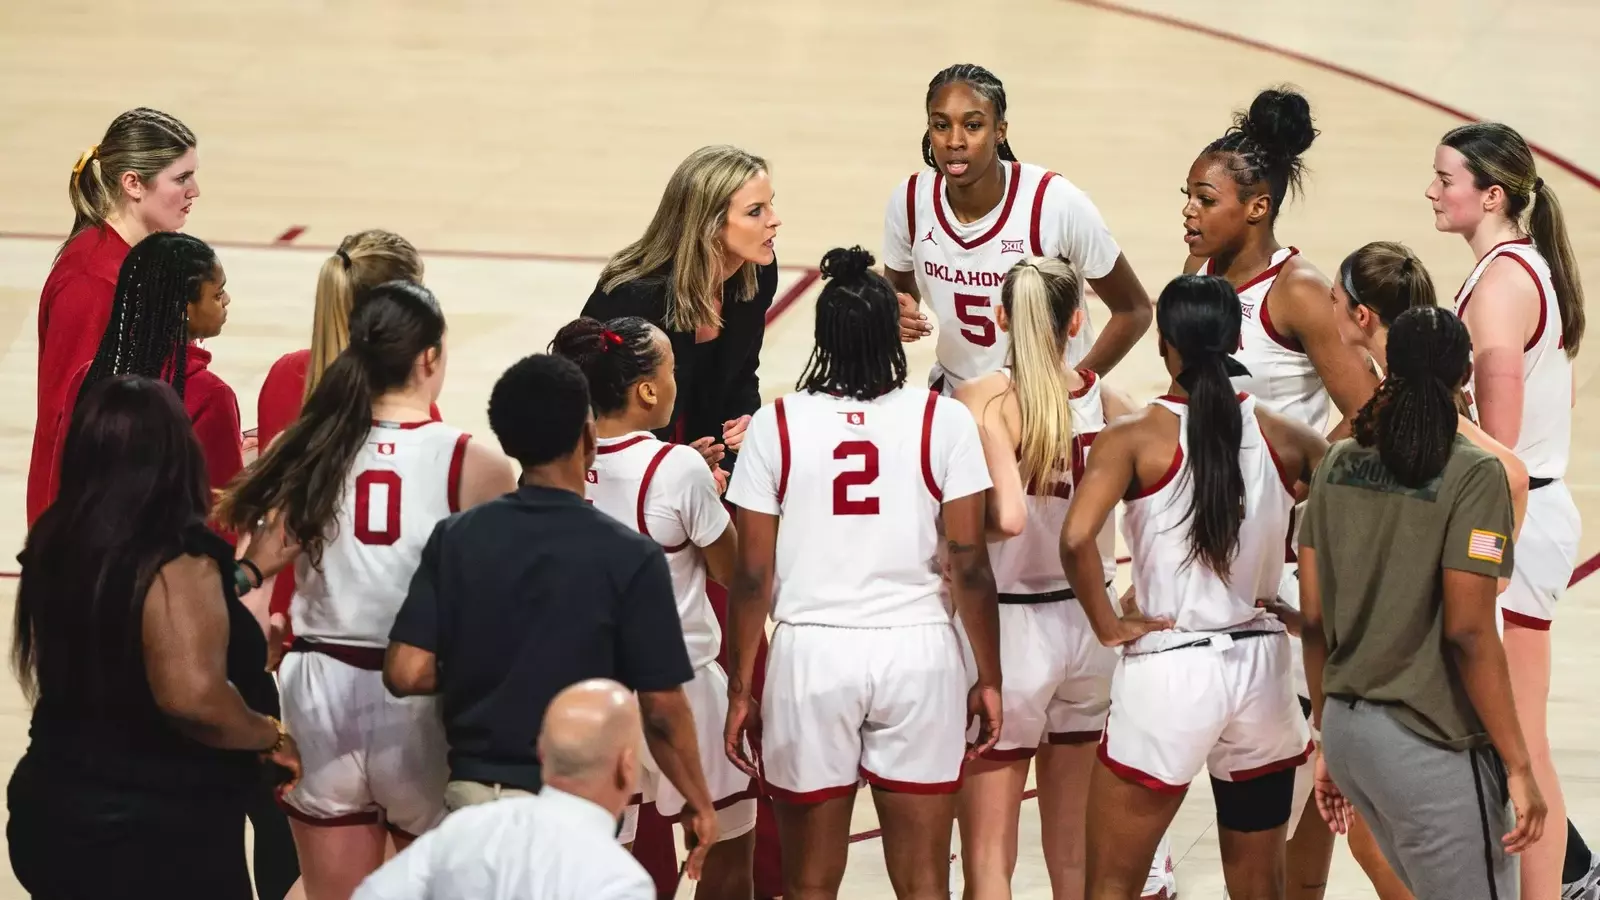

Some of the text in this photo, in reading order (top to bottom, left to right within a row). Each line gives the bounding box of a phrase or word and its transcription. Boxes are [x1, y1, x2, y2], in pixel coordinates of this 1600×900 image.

[954, 292, 996, 347] 5
[354, 470, 402, 546] 0
[833, 440, 879, 515] 2
